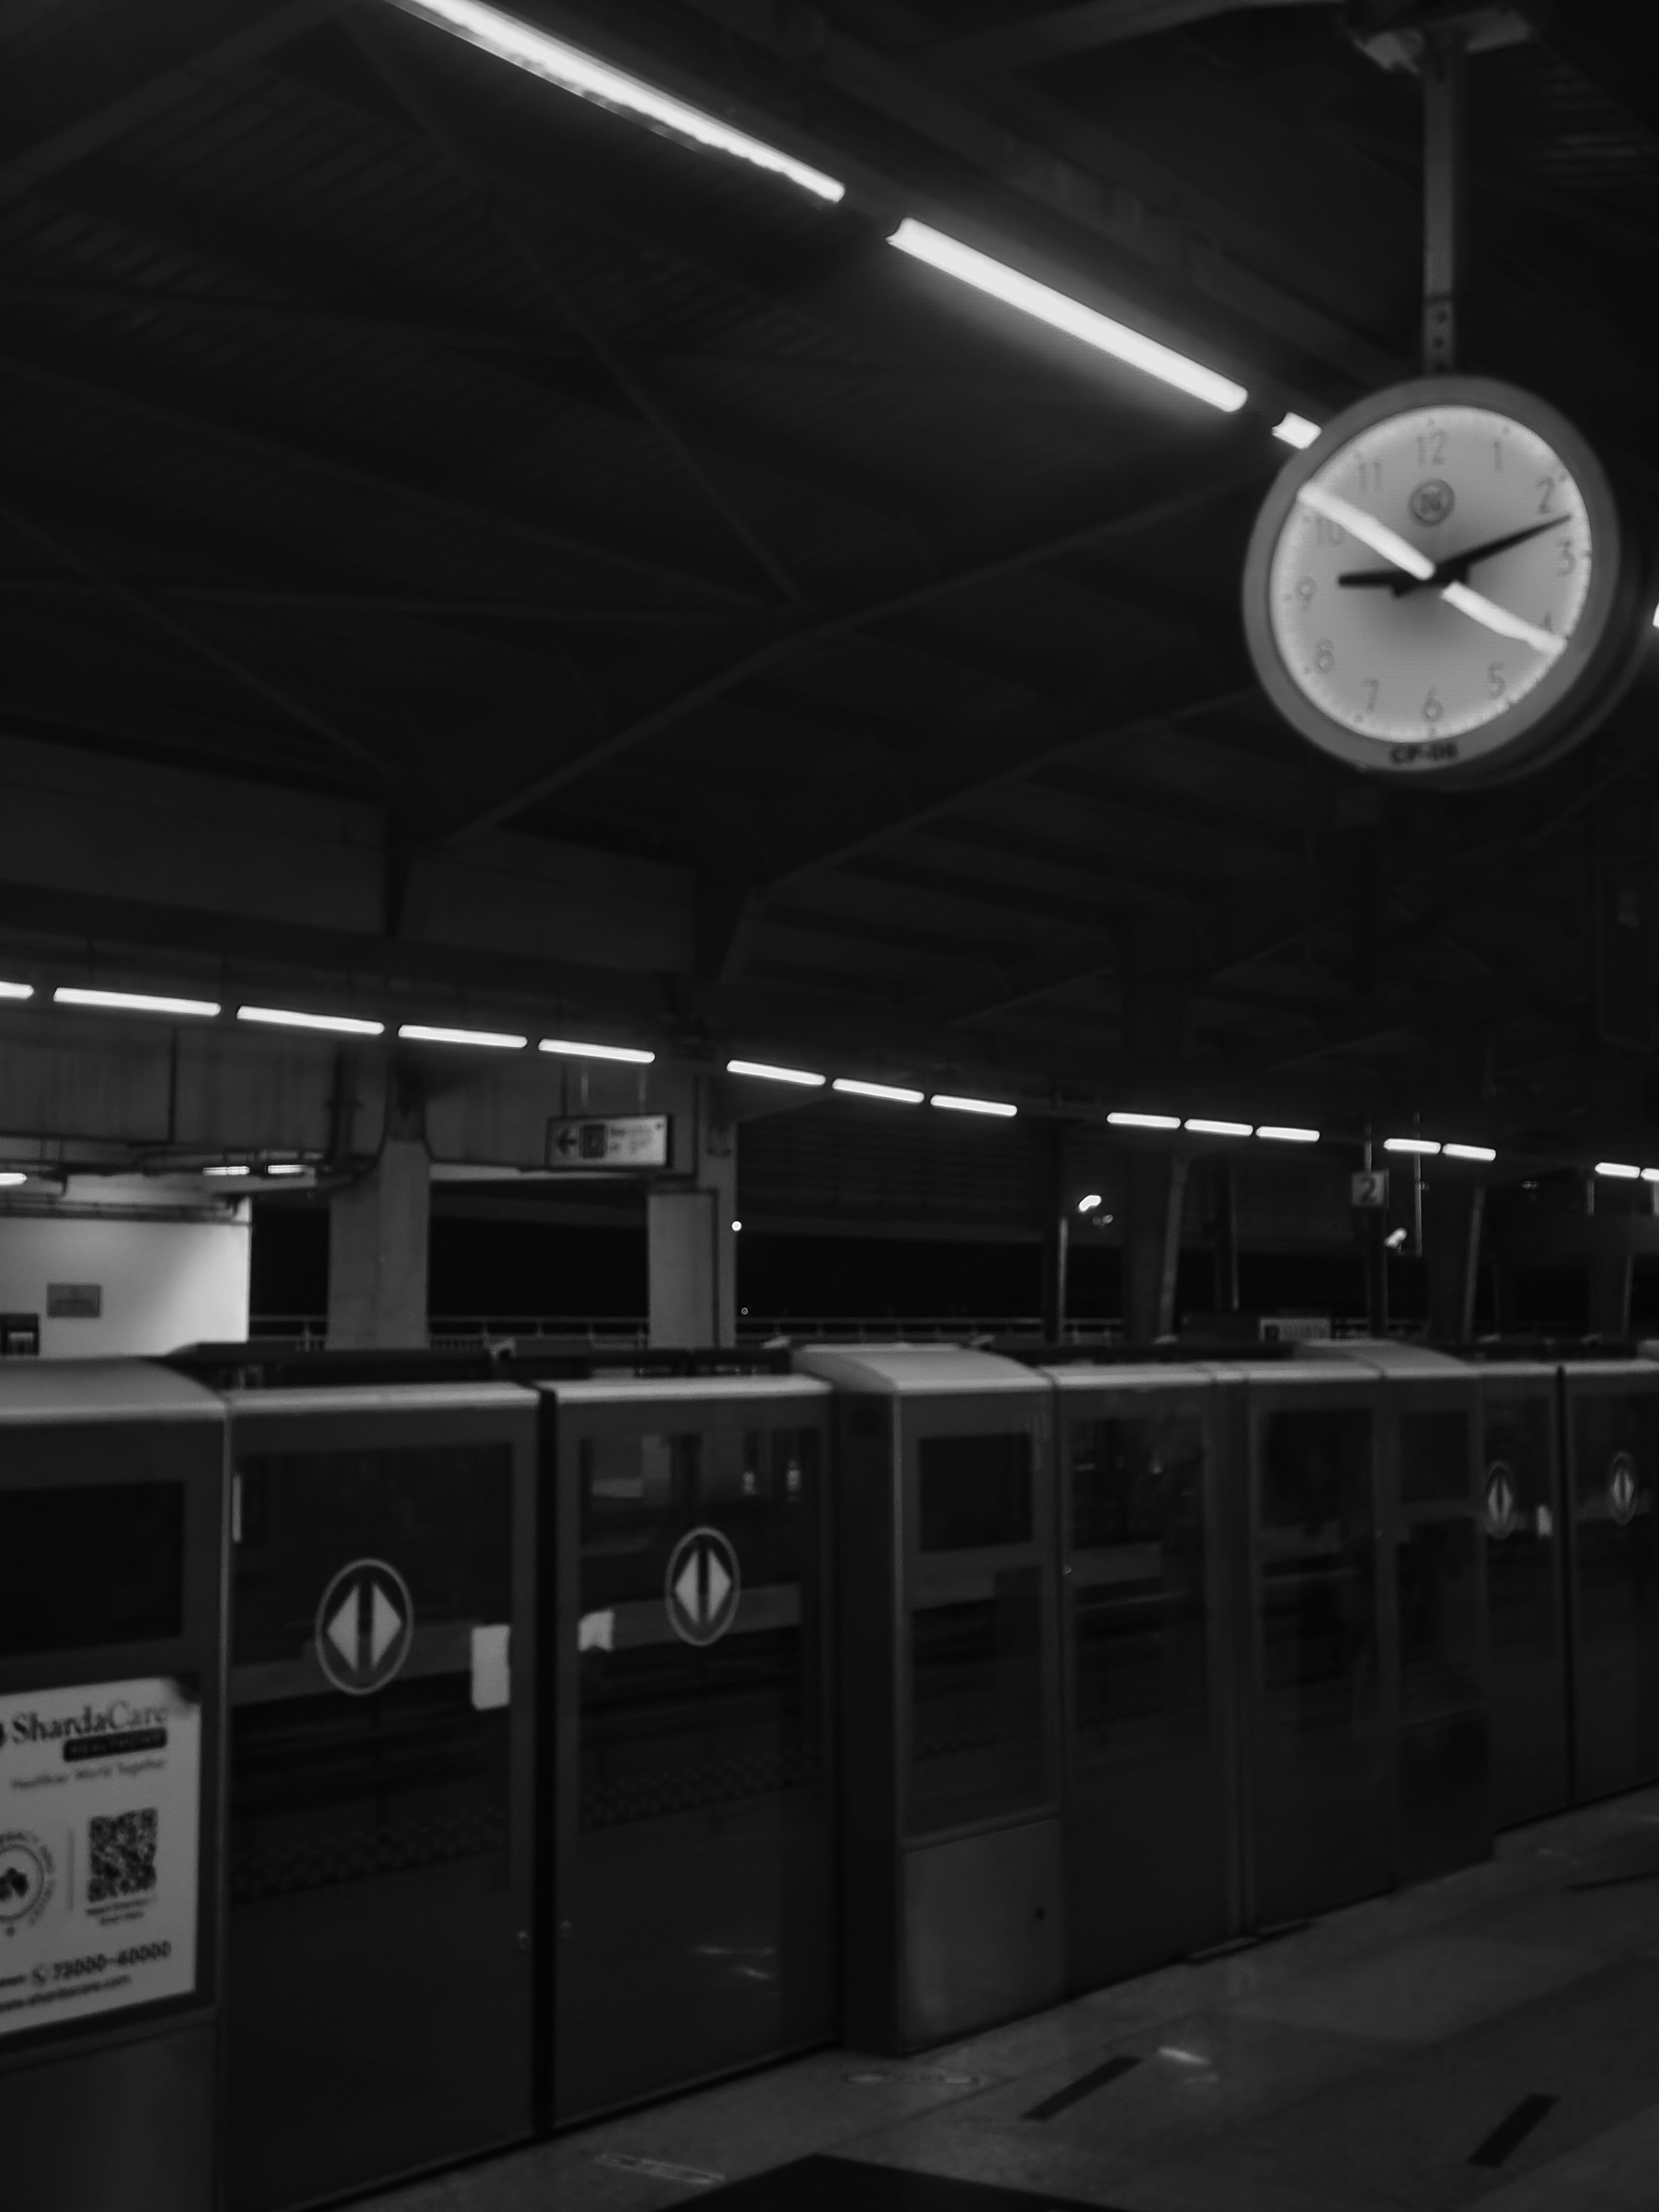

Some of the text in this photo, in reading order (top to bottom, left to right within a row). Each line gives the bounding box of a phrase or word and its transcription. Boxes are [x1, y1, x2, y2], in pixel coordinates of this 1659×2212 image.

[1416, 429, 1447, 466] 12
[1491, 440, 1503, 471] 1
[1356, 460, 1384, 493] 11
[1537, 475, 1555, 514] 2
[1556, 539, 1575, 578] 3
[1297, 576, 1317, 611] 9
[1314, 638, 1336, 674] 8
[1363, 678, 1380, 712] 7
[1487, 660, 1507, 698] 5
[1421, 688, 1444, 722] 6
[1360, 1177, 1377, 1204] 2
[12, 1699, 168, 1743] ShardaCare
